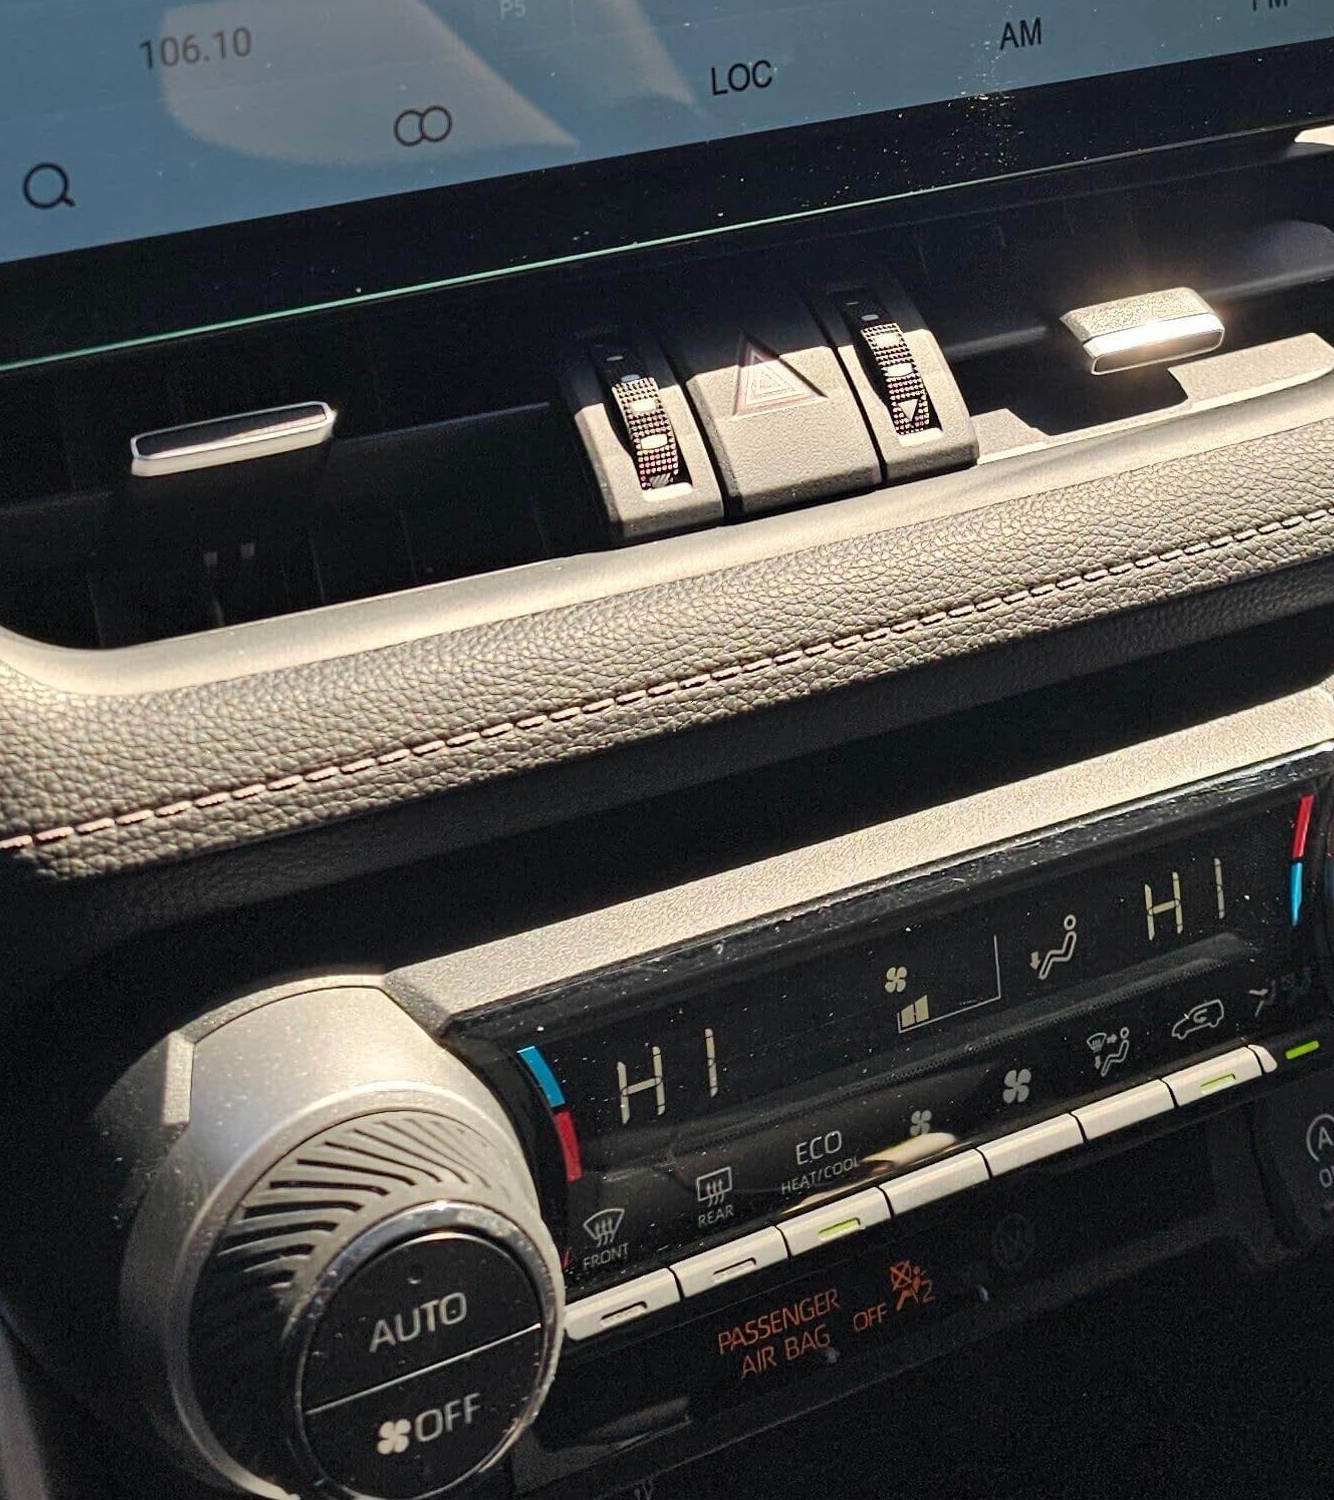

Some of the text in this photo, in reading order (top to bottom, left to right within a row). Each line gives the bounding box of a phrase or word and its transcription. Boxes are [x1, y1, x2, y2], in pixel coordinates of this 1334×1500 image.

[140, 26, 253, 70] 106.10
[999, 19, 1043, 51] AM
[710, 59, 774, 96] LOC
[1144, 856, 1227, 941] HI
[617, 1028, 719, 1126] HI
[795, 1130, 843, 1166] ECO
[780, 1156, 861, 1195] HEAT/COOL
[697, 1201, 735, 1228] REAR
[582, 1241, 630, 1273] FRONT
[369, 1290, 470, 1352] AUTO
[718, 1288, 841, 1355] PASSENGER
[854, 1302, 889, 1333] OFF
[740, 1327, 832, 1380] AIR BAG
[414, 1393, 482, 1444] OFF
